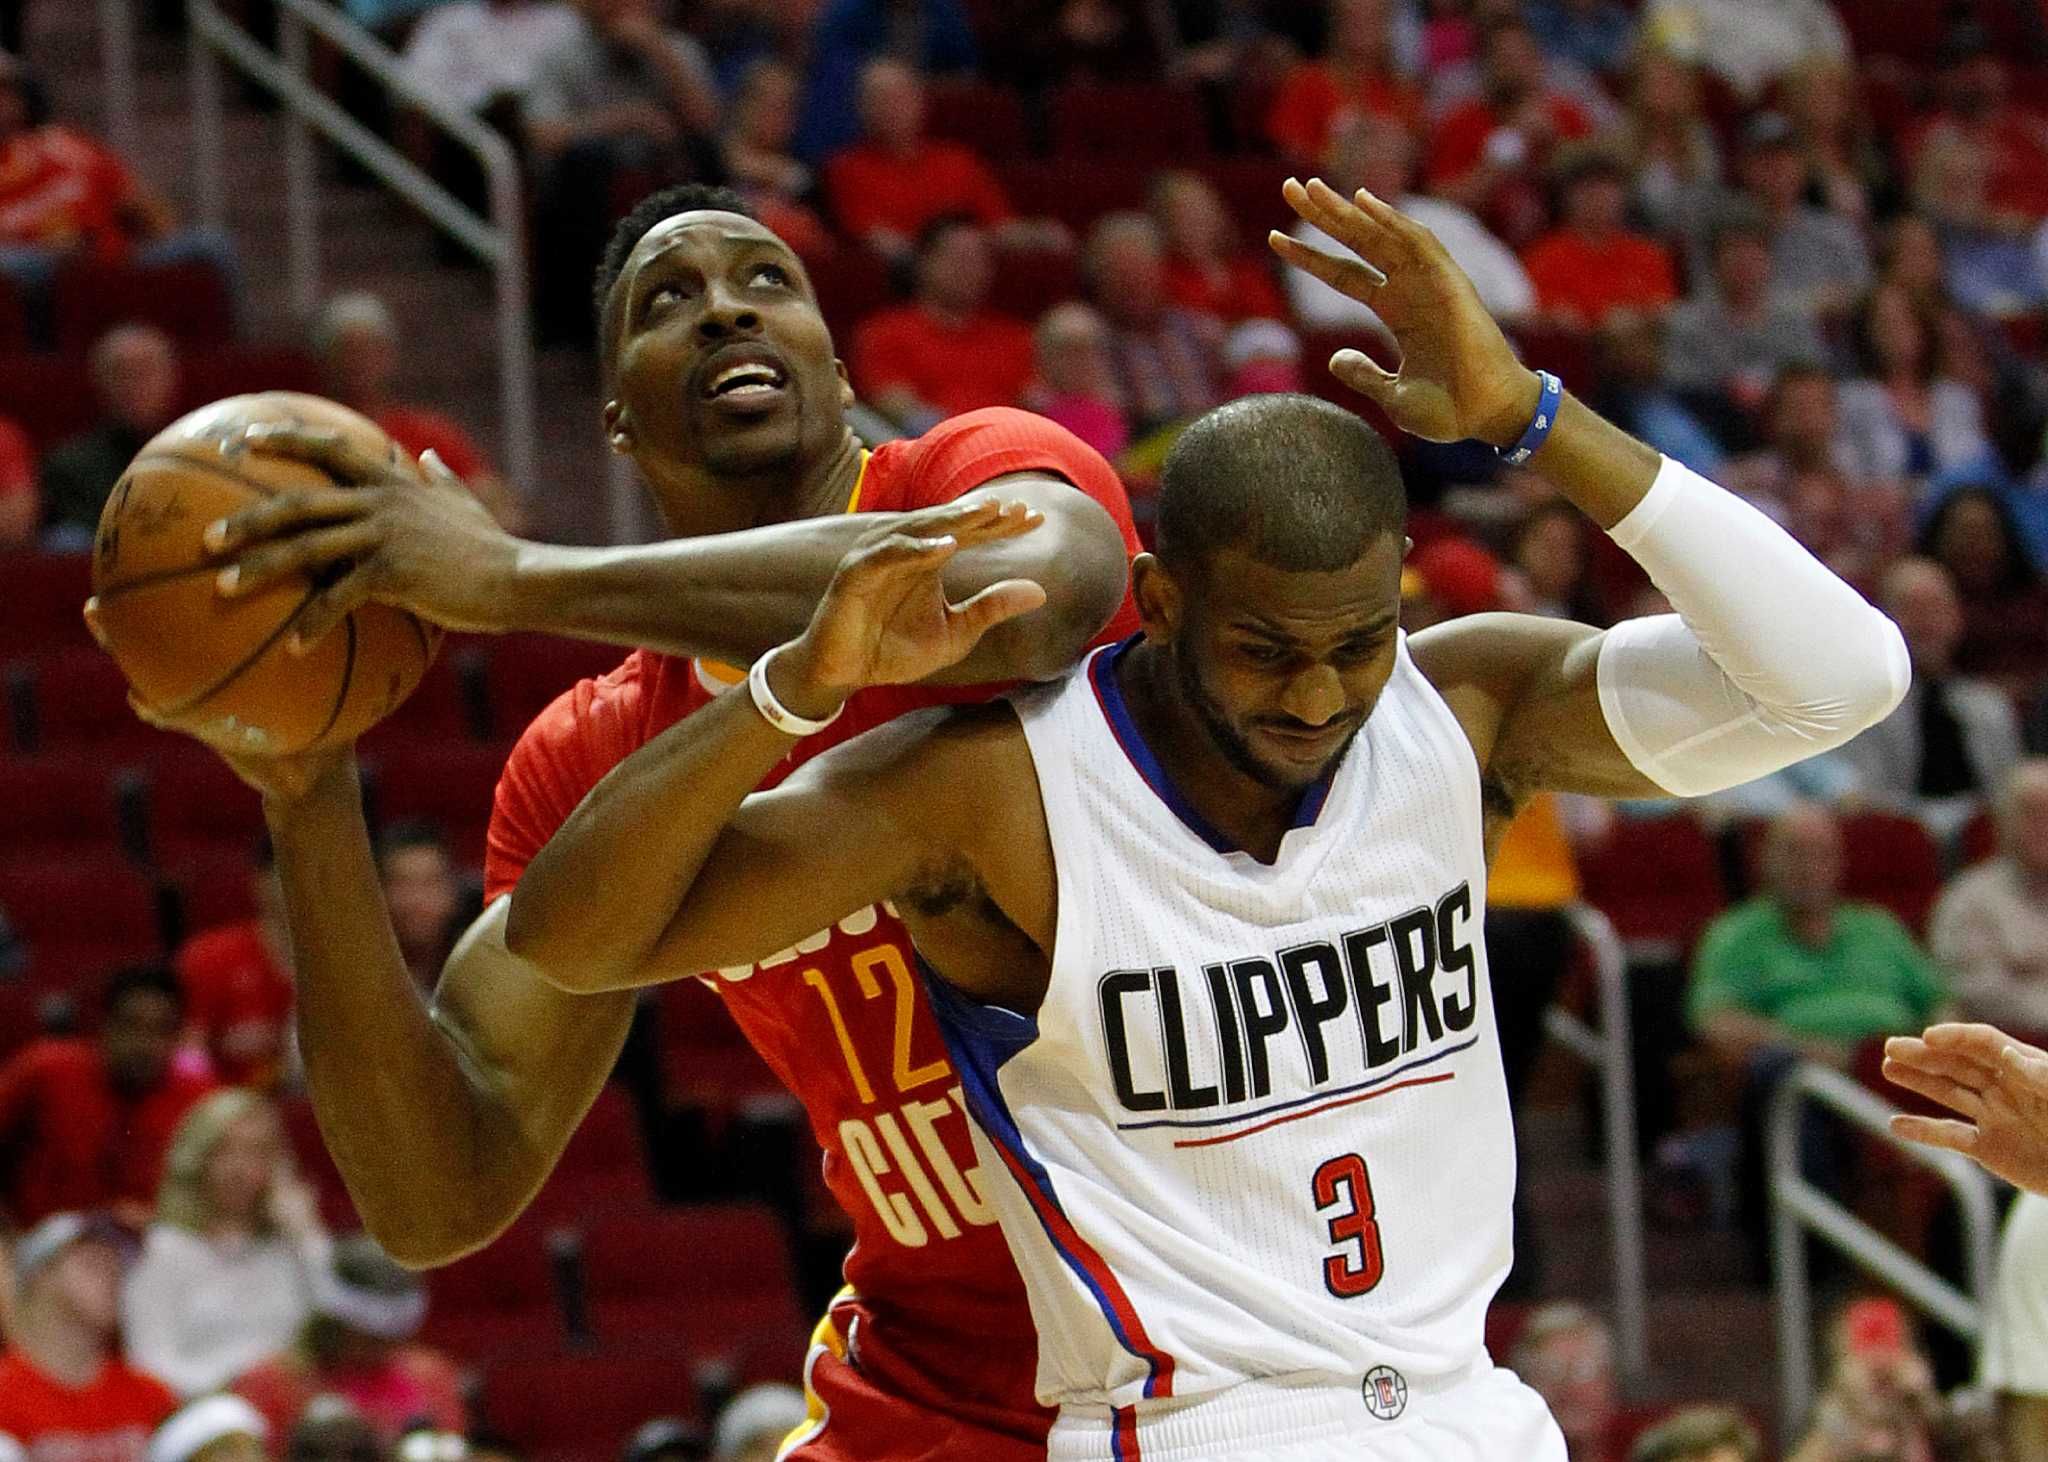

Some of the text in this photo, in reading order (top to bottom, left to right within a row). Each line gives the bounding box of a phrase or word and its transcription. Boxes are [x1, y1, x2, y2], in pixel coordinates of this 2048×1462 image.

[803, 943, 952, 1104] 12
[1097, 879, 1478, 1112] CLIPPERS
[838, 1085, 999, 1248] CIT
[1311, 1152, 1384, 1299] 3
